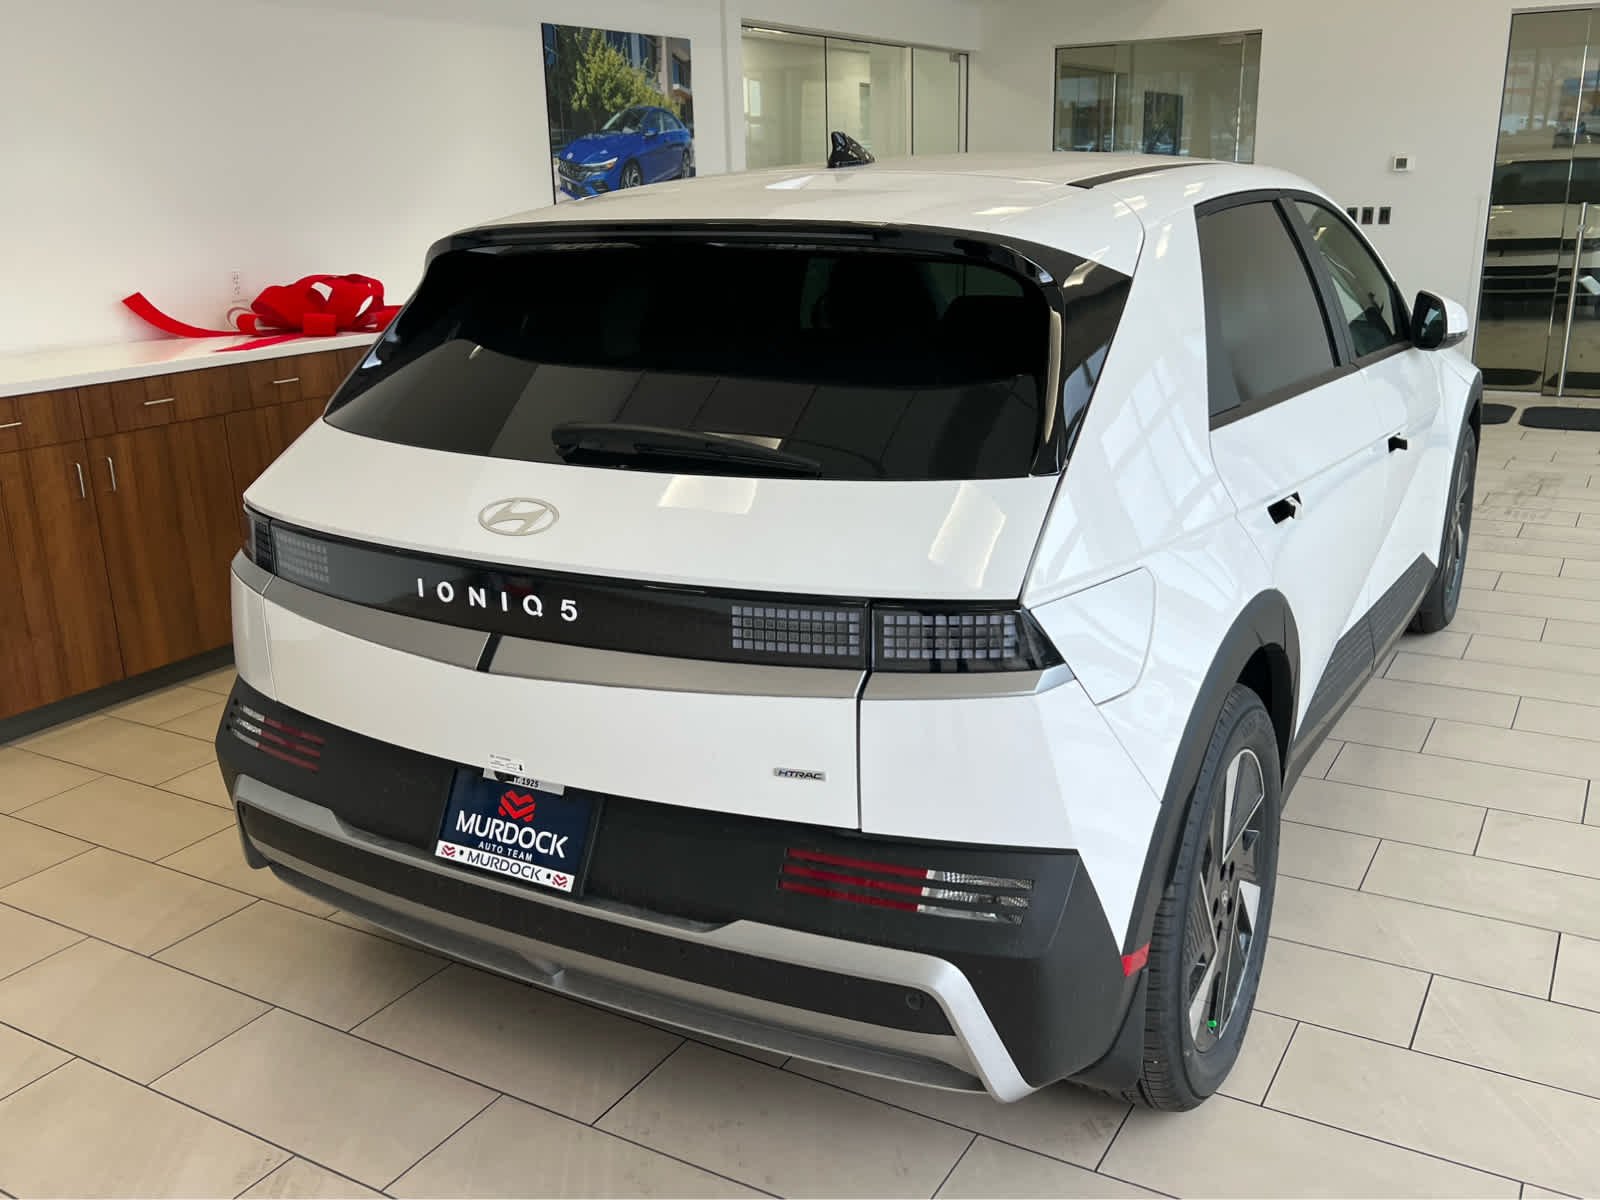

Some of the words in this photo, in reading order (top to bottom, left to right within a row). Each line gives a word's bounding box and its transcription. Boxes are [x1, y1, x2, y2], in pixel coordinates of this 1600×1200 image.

[417, 578, 543, 617] IONIQ
[560, 599, 578, 622] 5
[521, 777, 539, 788] 1925
[778, 769, 823, 780] HTRAC
[455, 810, 569, 858] MURDOCK
[478, 841, 503, 854] AUTO
[507, 848, 533, 862] TEAM
[466, 850, 542, 881] MURDOCK
